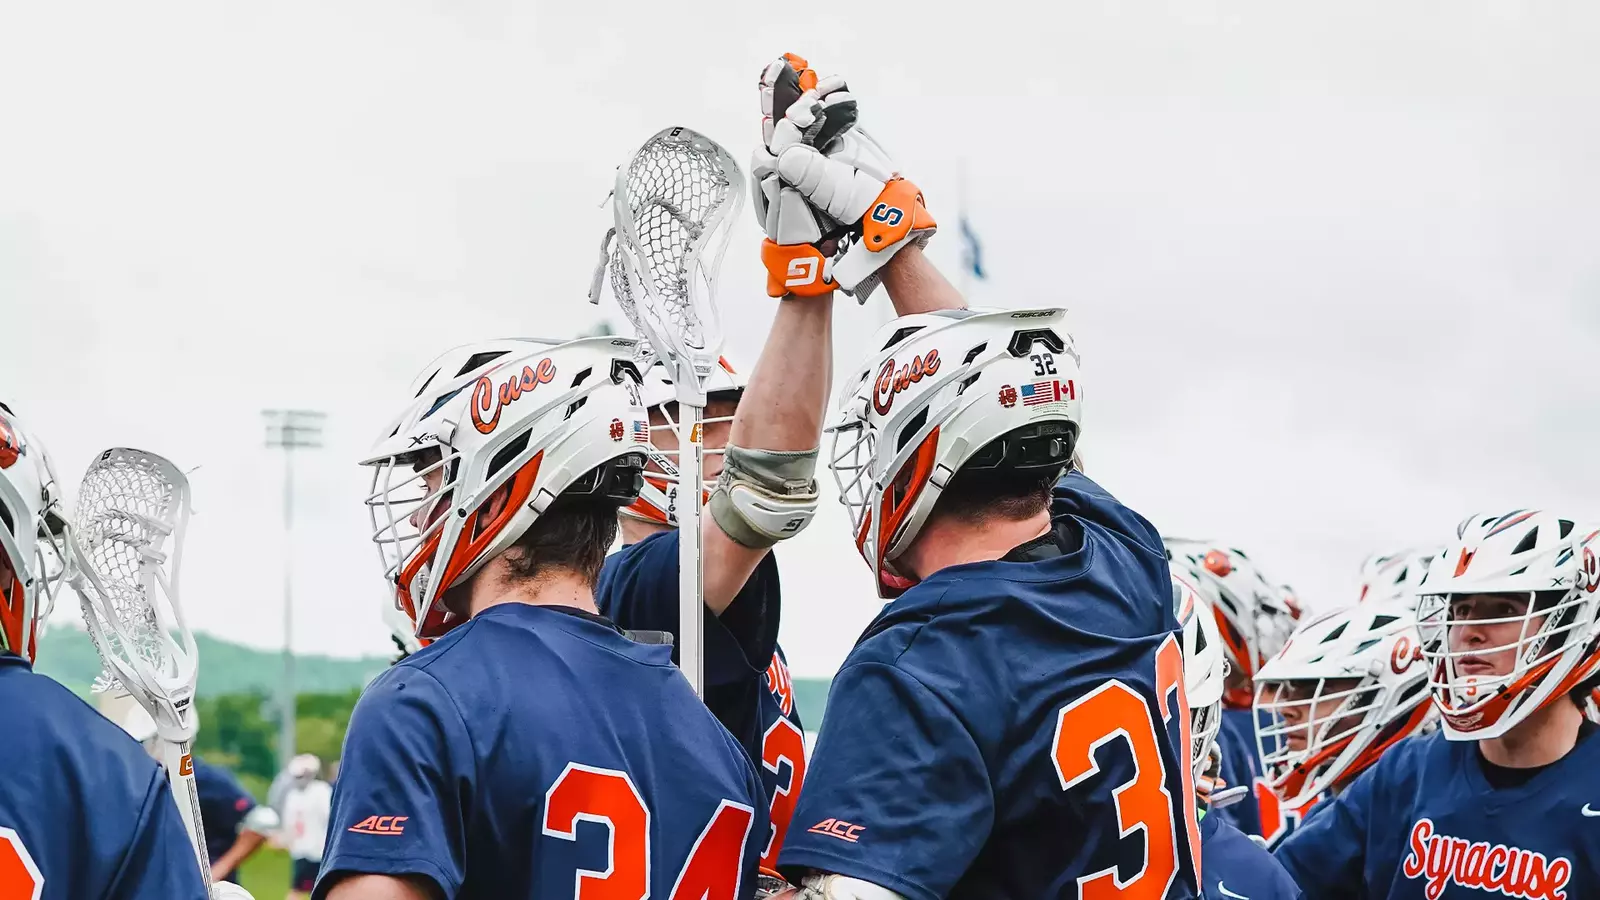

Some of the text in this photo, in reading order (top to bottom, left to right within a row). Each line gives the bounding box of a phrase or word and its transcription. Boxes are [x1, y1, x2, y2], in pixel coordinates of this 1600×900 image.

[670, 126, 684, 137] G
[872, 203, 904, 227] S
[785, 256, 820, 287] G
[1029, 352, 1058, 377] 32
[873, 348, 942, 417] Cuse
[471, 357, 557, 435] Cuse
[349, 815, 409, 833] ACC
[809, 818, 866, 840] ACC
[1403, 818, 1572, 900] Syracuse
